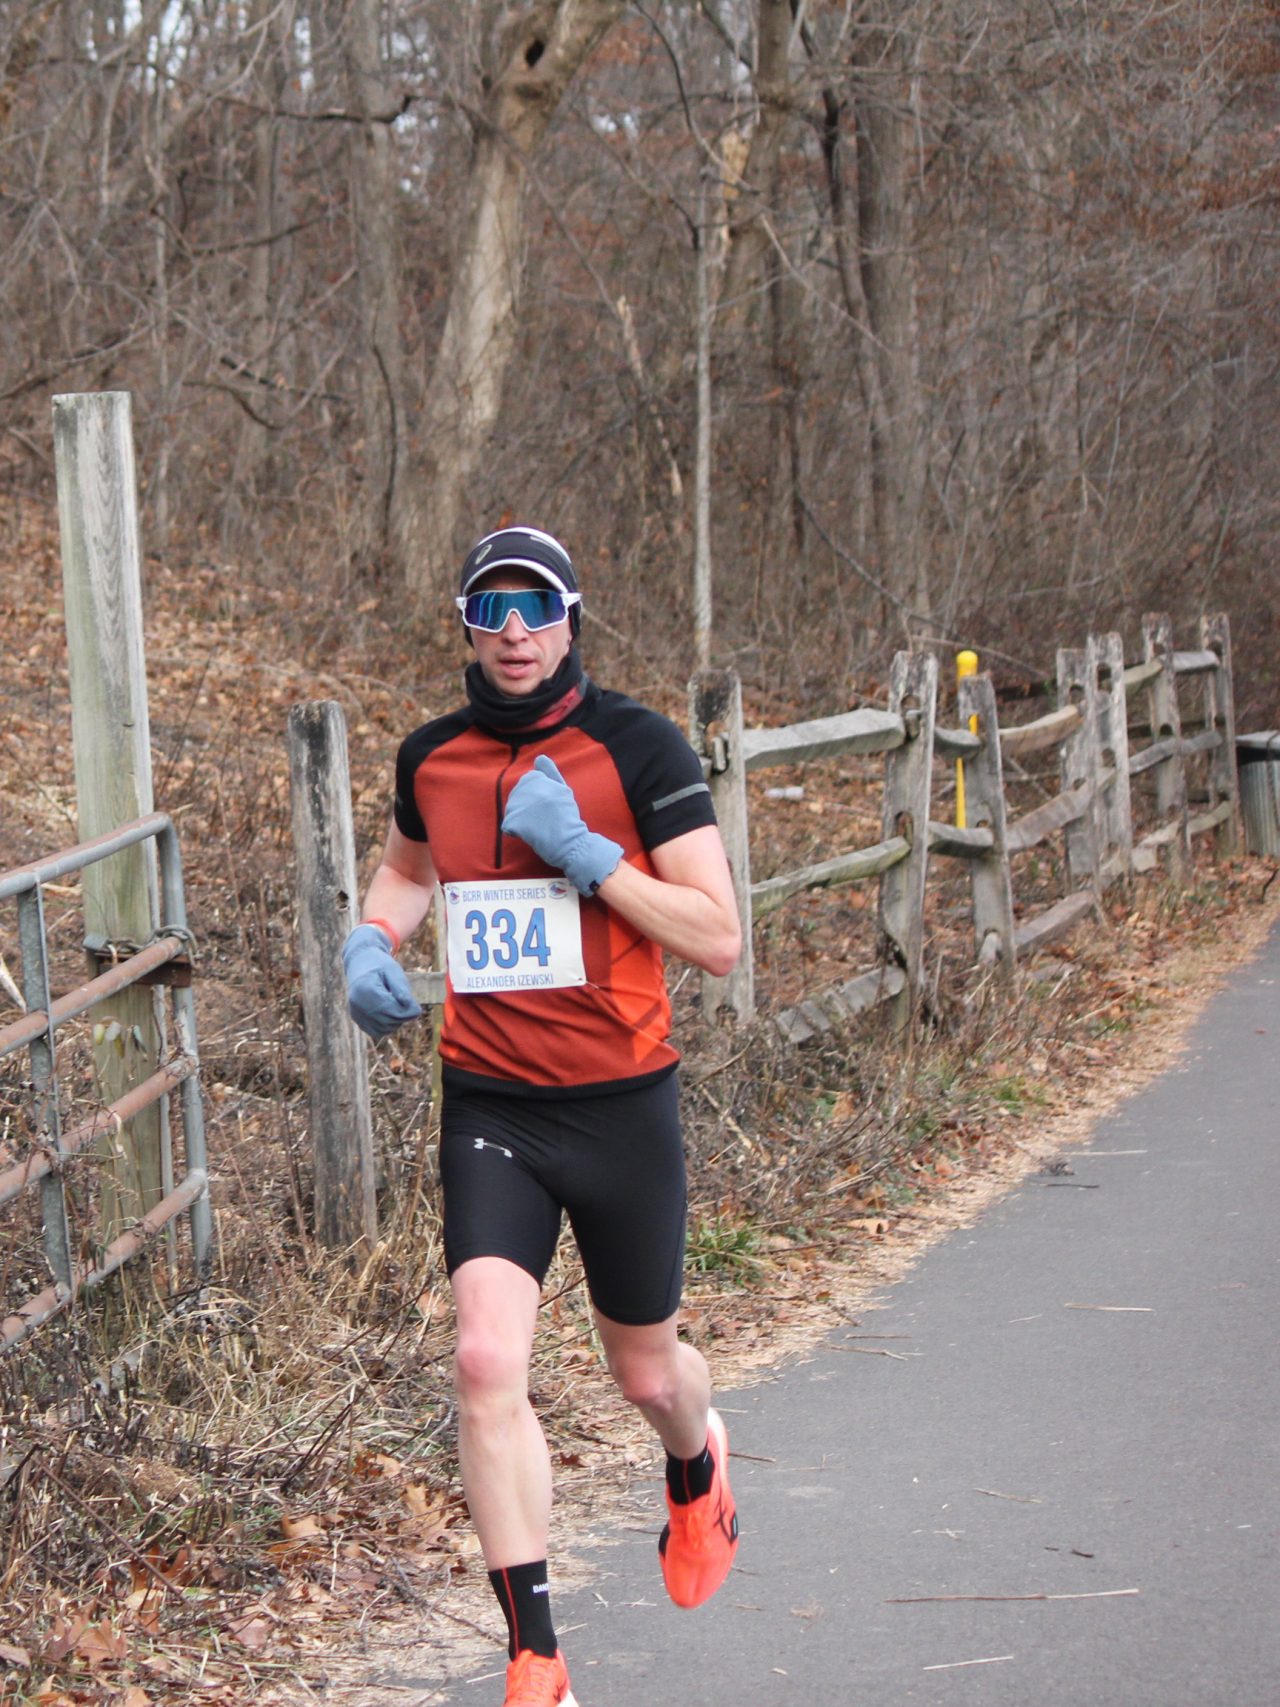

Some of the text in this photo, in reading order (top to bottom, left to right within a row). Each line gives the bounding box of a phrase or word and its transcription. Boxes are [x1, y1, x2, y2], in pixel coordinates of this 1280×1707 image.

[484, 889, 515, 901] WINTER
[516, 888, 546, 900] SERIES
[465, 908, 552, 971] 334
[468, 974, 554, 988] ALEXANDER IZEWSKI
